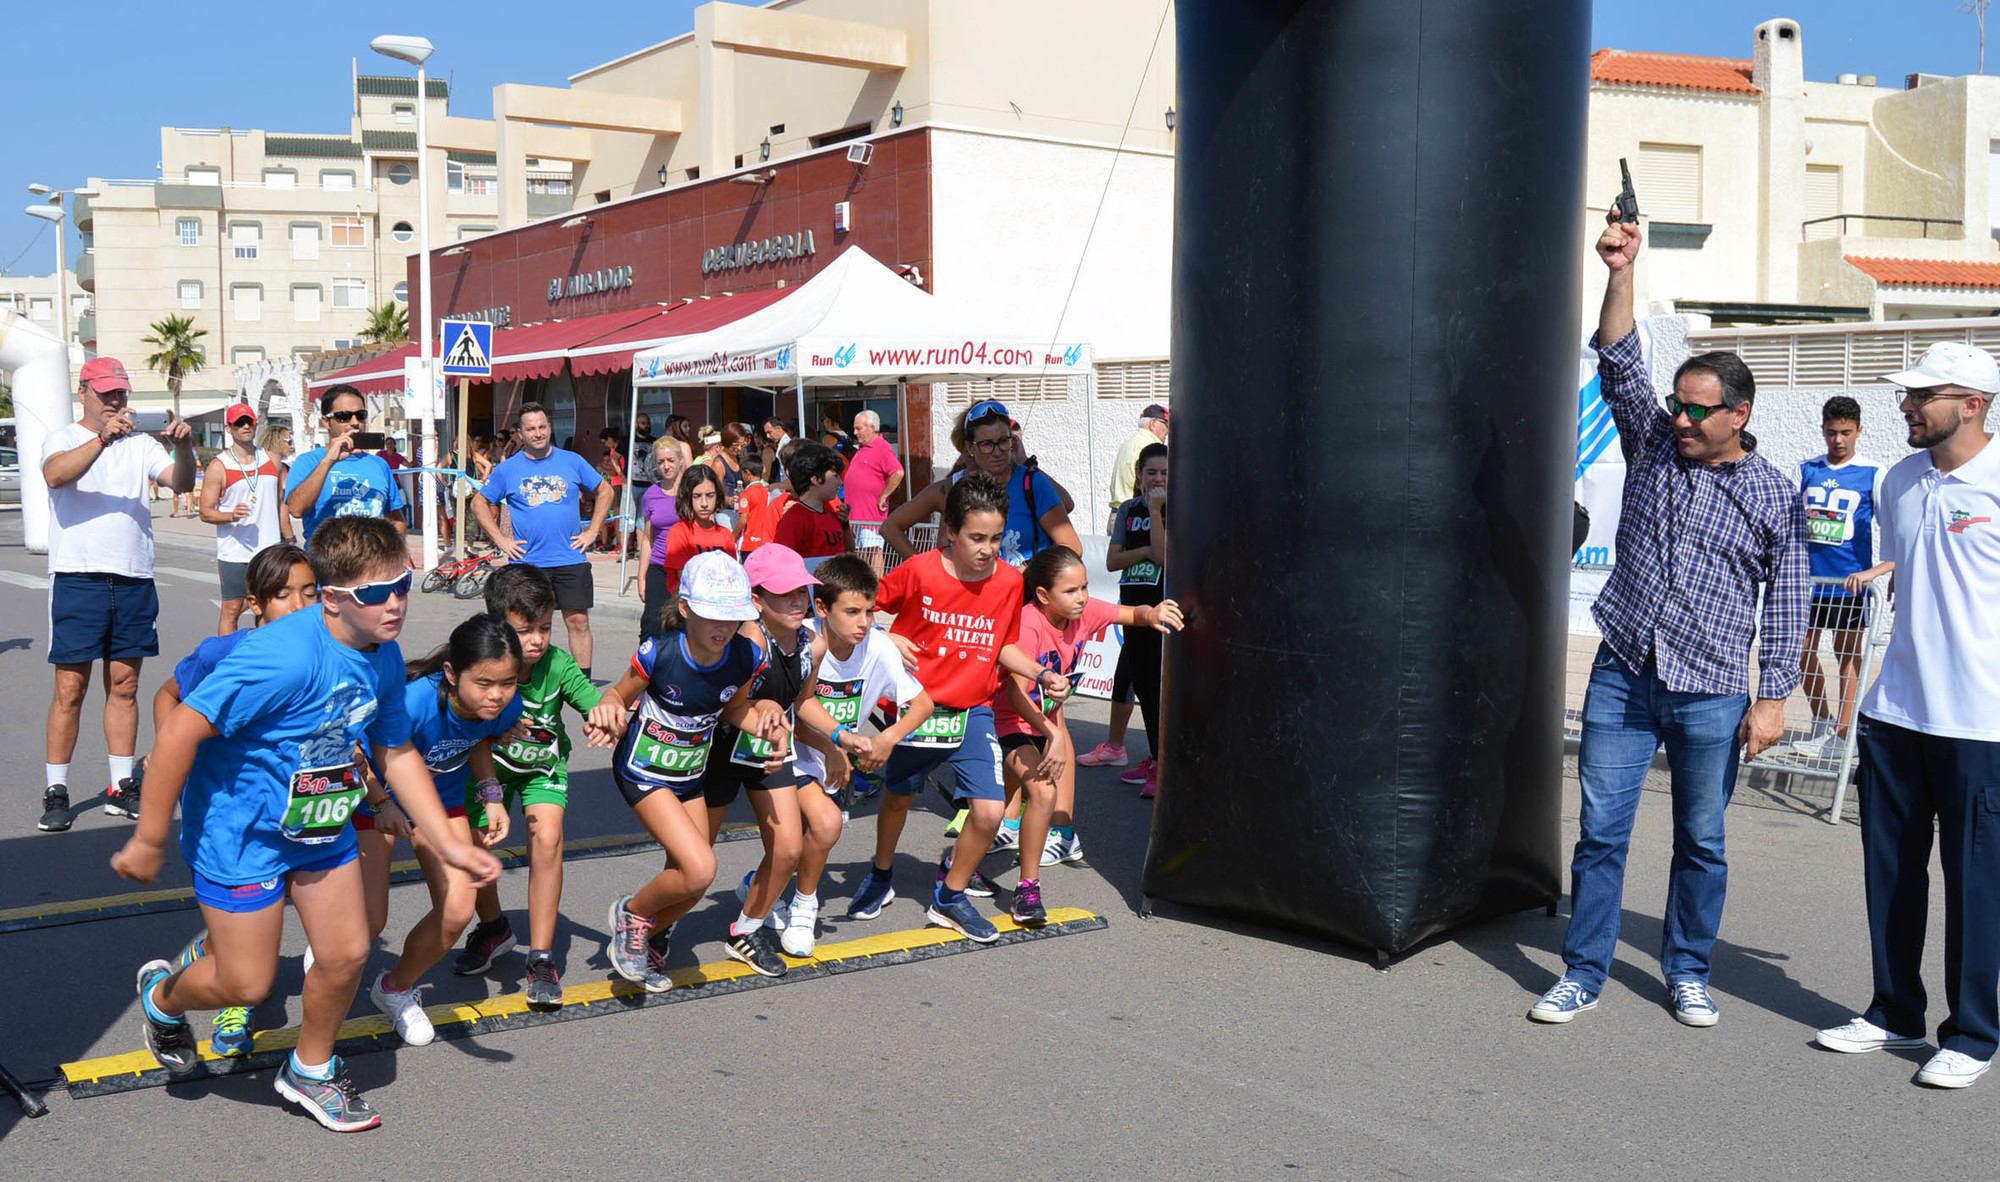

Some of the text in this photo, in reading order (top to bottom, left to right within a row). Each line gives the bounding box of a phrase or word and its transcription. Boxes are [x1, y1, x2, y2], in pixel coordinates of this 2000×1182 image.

[811, 354, 833, 367] Run
[868, 341, 1033, 367] www.run04.com
[1044, 354, 1063, 366] Run
[664, 352, 758, 377] www.run04.com
[922, 606, 995, 631] TRIATLÓN
[943, 627, 995, 647] ATLETI
[921, 715, 961, 734] 056
[507, 742, 553, 762] 069
[647, 744, 705, 769] 1072
